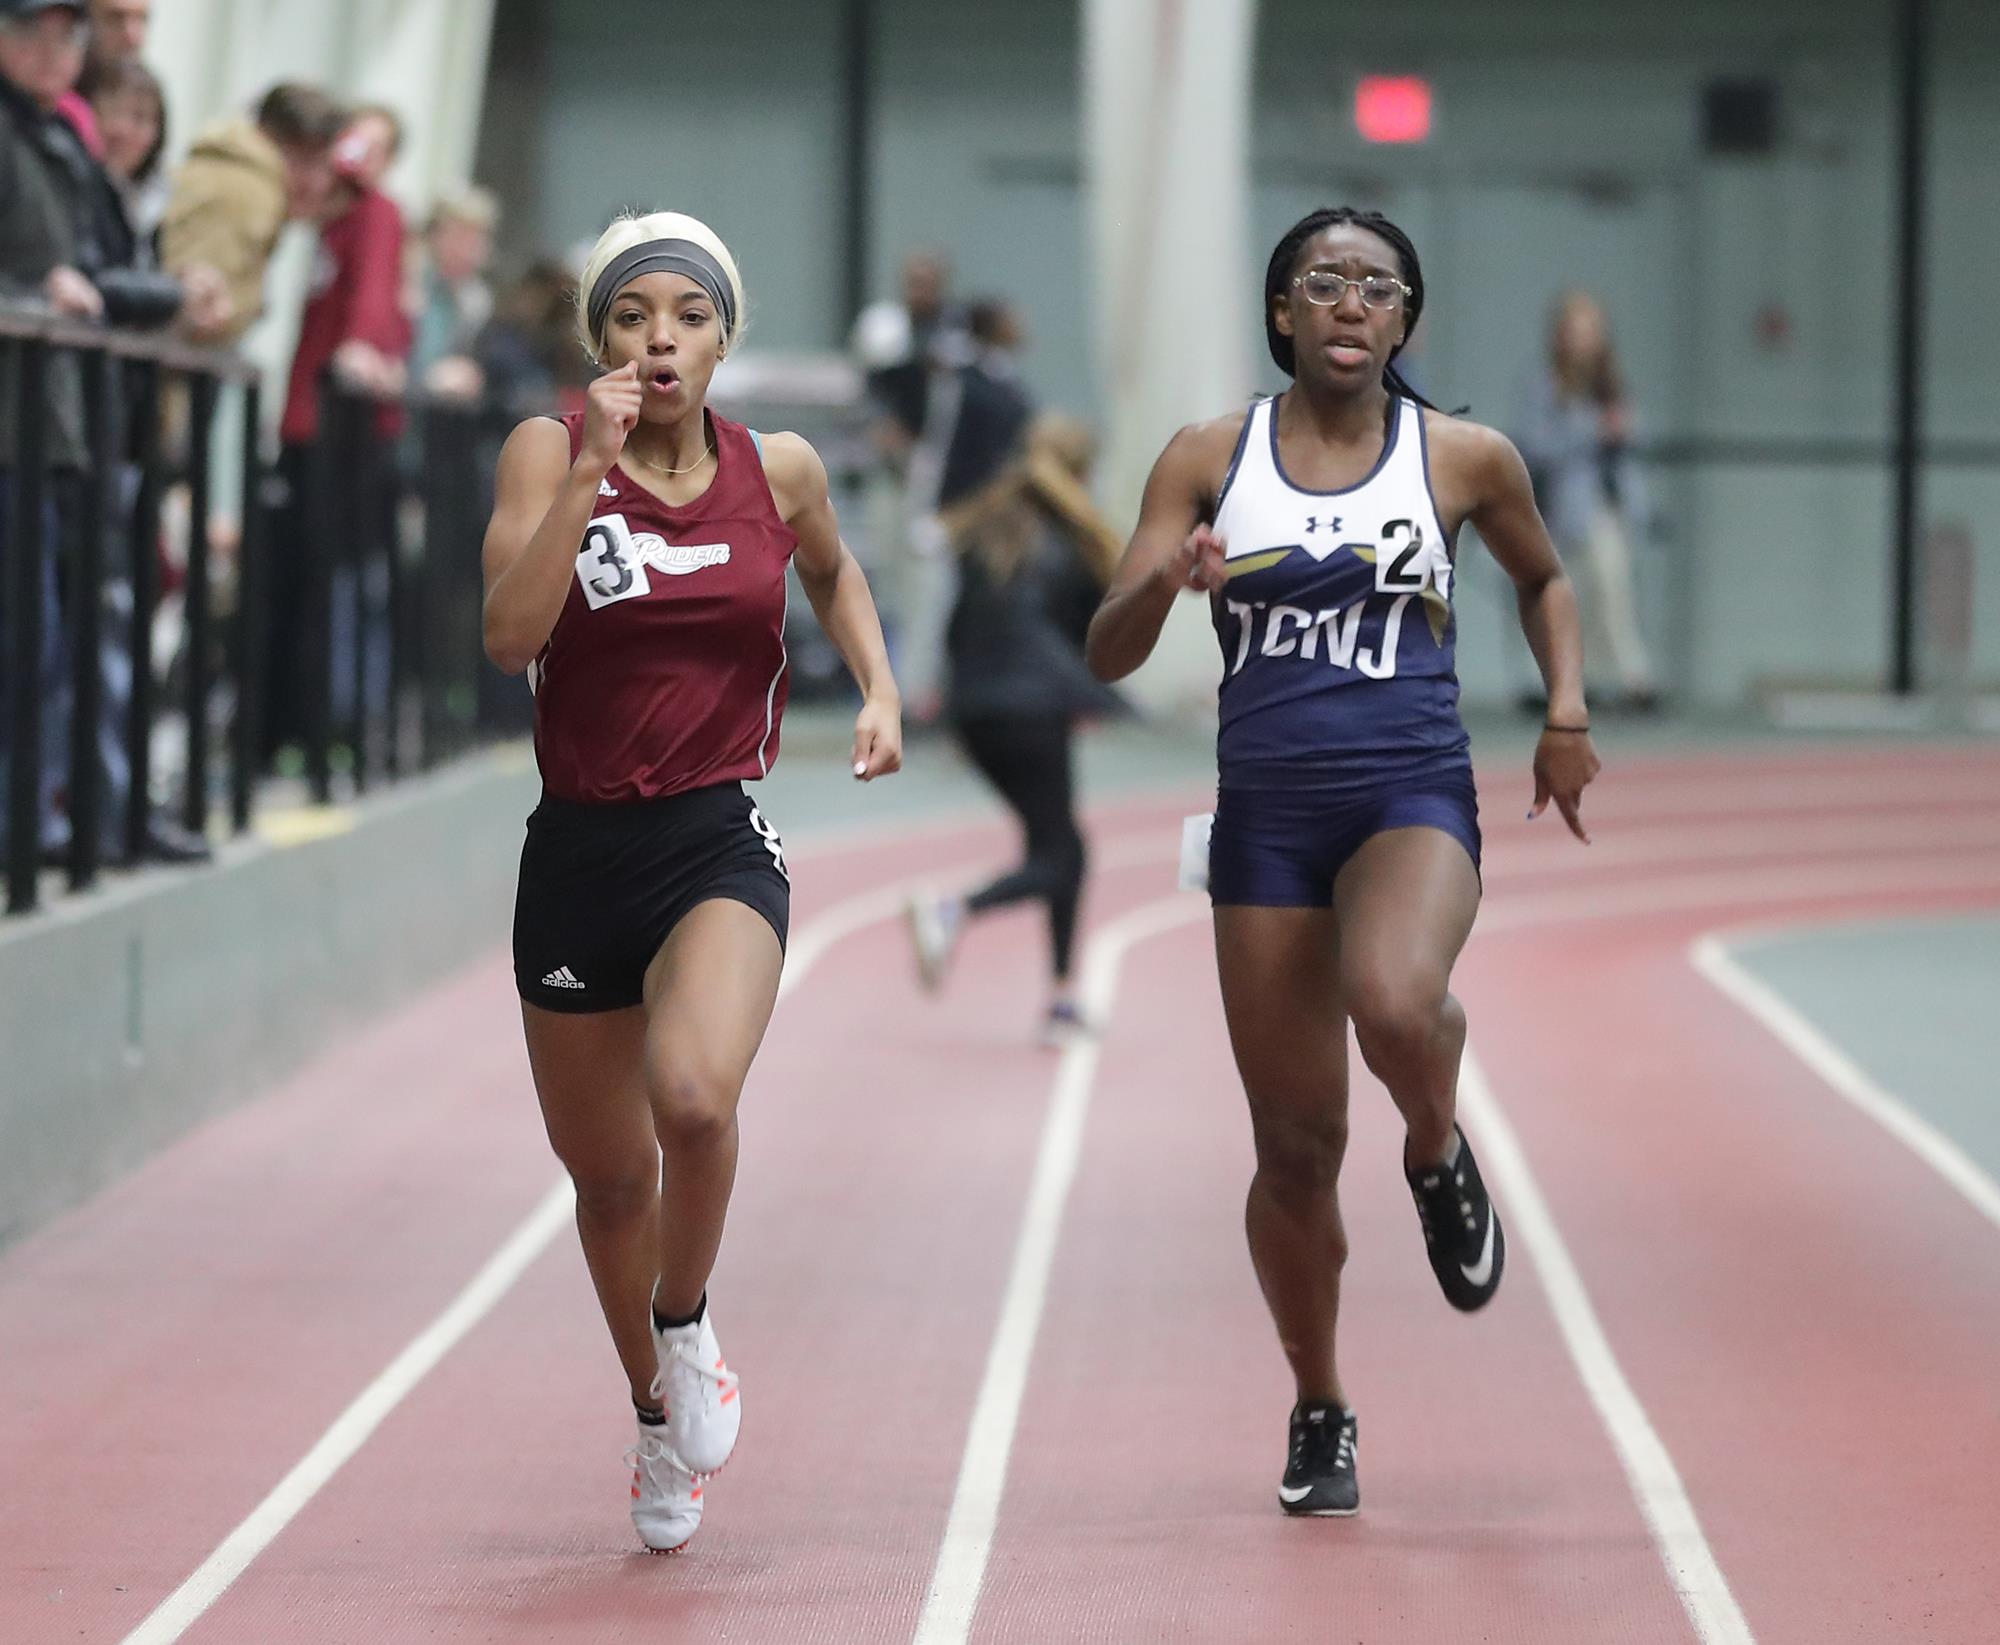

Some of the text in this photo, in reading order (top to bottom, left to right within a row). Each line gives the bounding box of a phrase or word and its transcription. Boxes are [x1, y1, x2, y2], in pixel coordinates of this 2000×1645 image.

[579, 524, 634, 598] 3
[1381, 518, 1424, 586] 2
[1226, 593, 1418, 680] TCNJ
[541, 977, 586, 989] adidas
